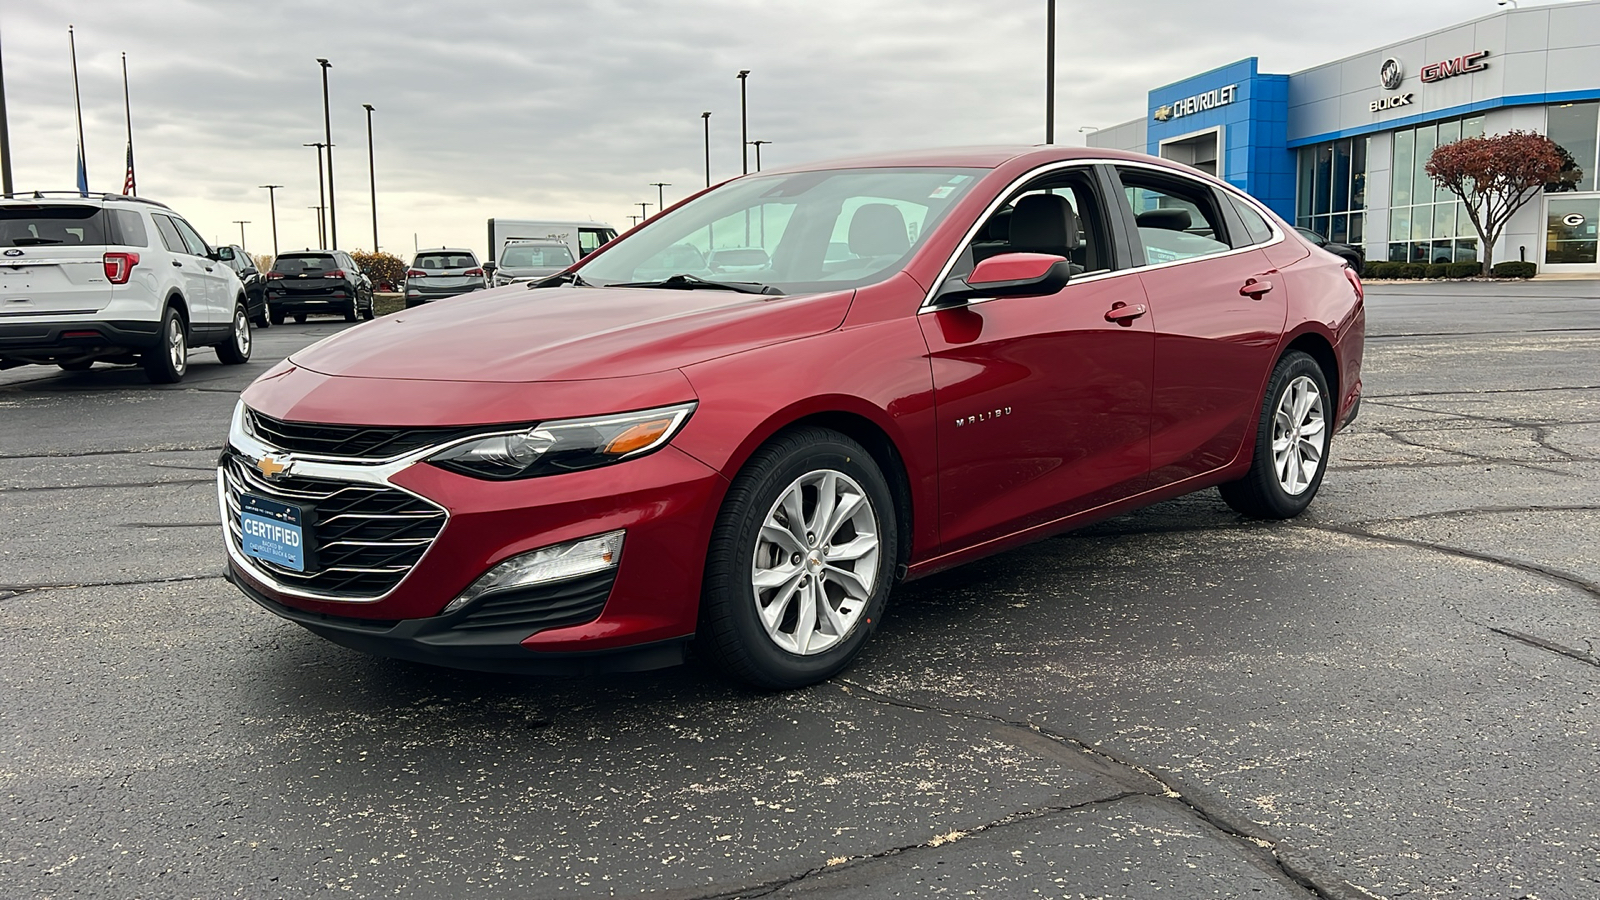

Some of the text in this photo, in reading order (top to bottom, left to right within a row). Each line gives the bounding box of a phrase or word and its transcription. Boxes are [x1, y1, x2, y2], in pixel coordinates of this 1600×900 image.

[1420, 50, 1487, 83] GMC
[1173, 84, 1237, 118] CHEVROLET
[1369, 93, 1411, 112] BUICK
[956, 406, 1012, 428] MALIBU
[244, 518, 299, 548] CERTIFIED
[249, 542, 272, 553] CHEVROLET
[272, 549, 284, 557] BUICK
[262, 540, 277, 549] BACKED
